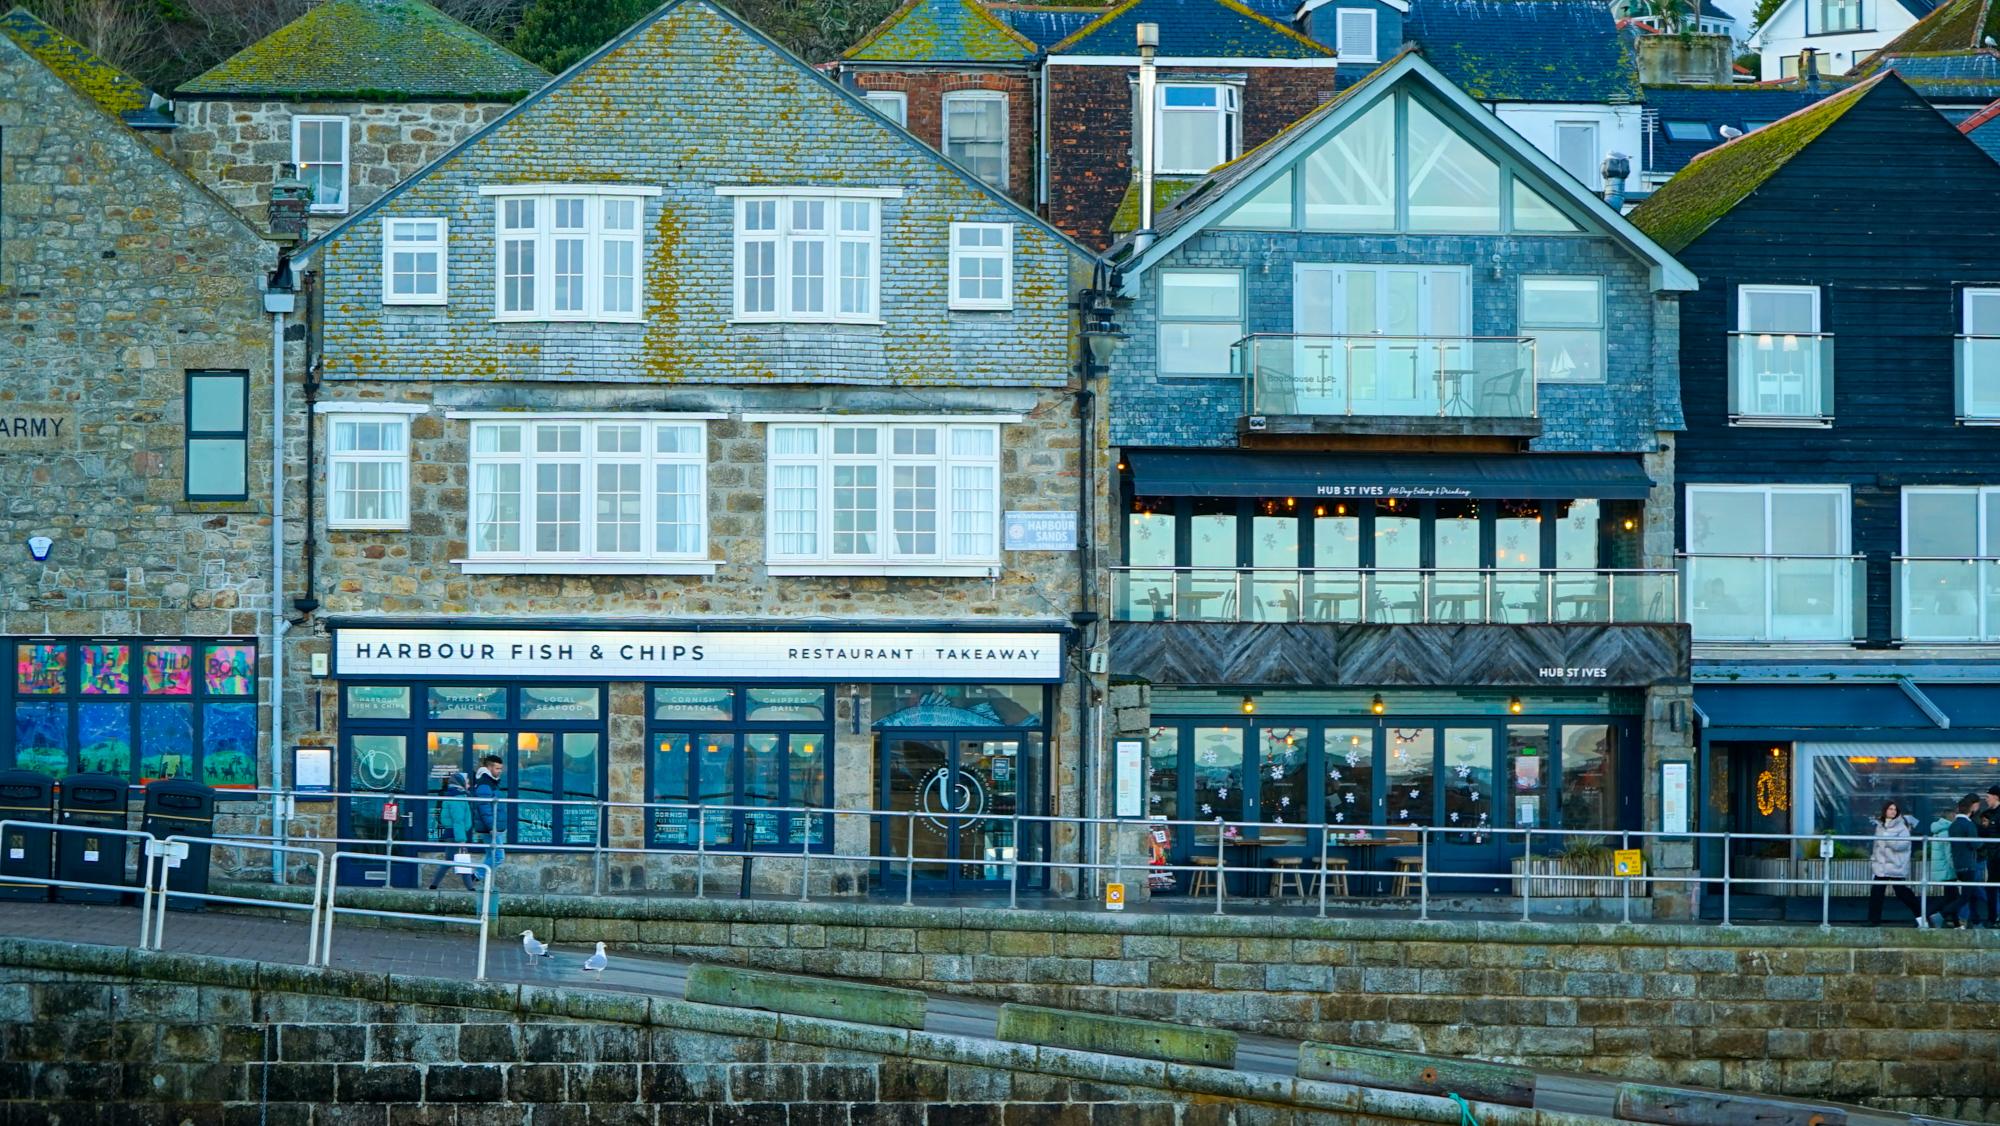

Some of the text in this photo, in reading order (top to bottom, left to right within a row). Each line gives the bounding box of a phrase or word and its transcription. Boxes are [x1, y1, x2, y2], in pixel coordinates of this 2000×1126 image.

[0, 417, 64, 437] ARMY
[1317, 486, 1384, 495] HUB ST IVES
[1440, 486, 1472, 497] Drinking
[1027, 520, 1076, 531] HARBOUR
[1036, 531, 1068, 542] SANDS
[356, 643, 704, 661] HARBOUR FISH & CHIPS
[788, 648, 1039, 660] RESTAURANT TAKEAWAY
[1539, 667, 1607, 678] HUB ST IVES
[447, 703, 488, 711] CAUGHT
[536, 704, 583, 712] SEAFOOD
[667, 704, 718, 712] POTATOES
[770, 704, 800, 712] DAILY
